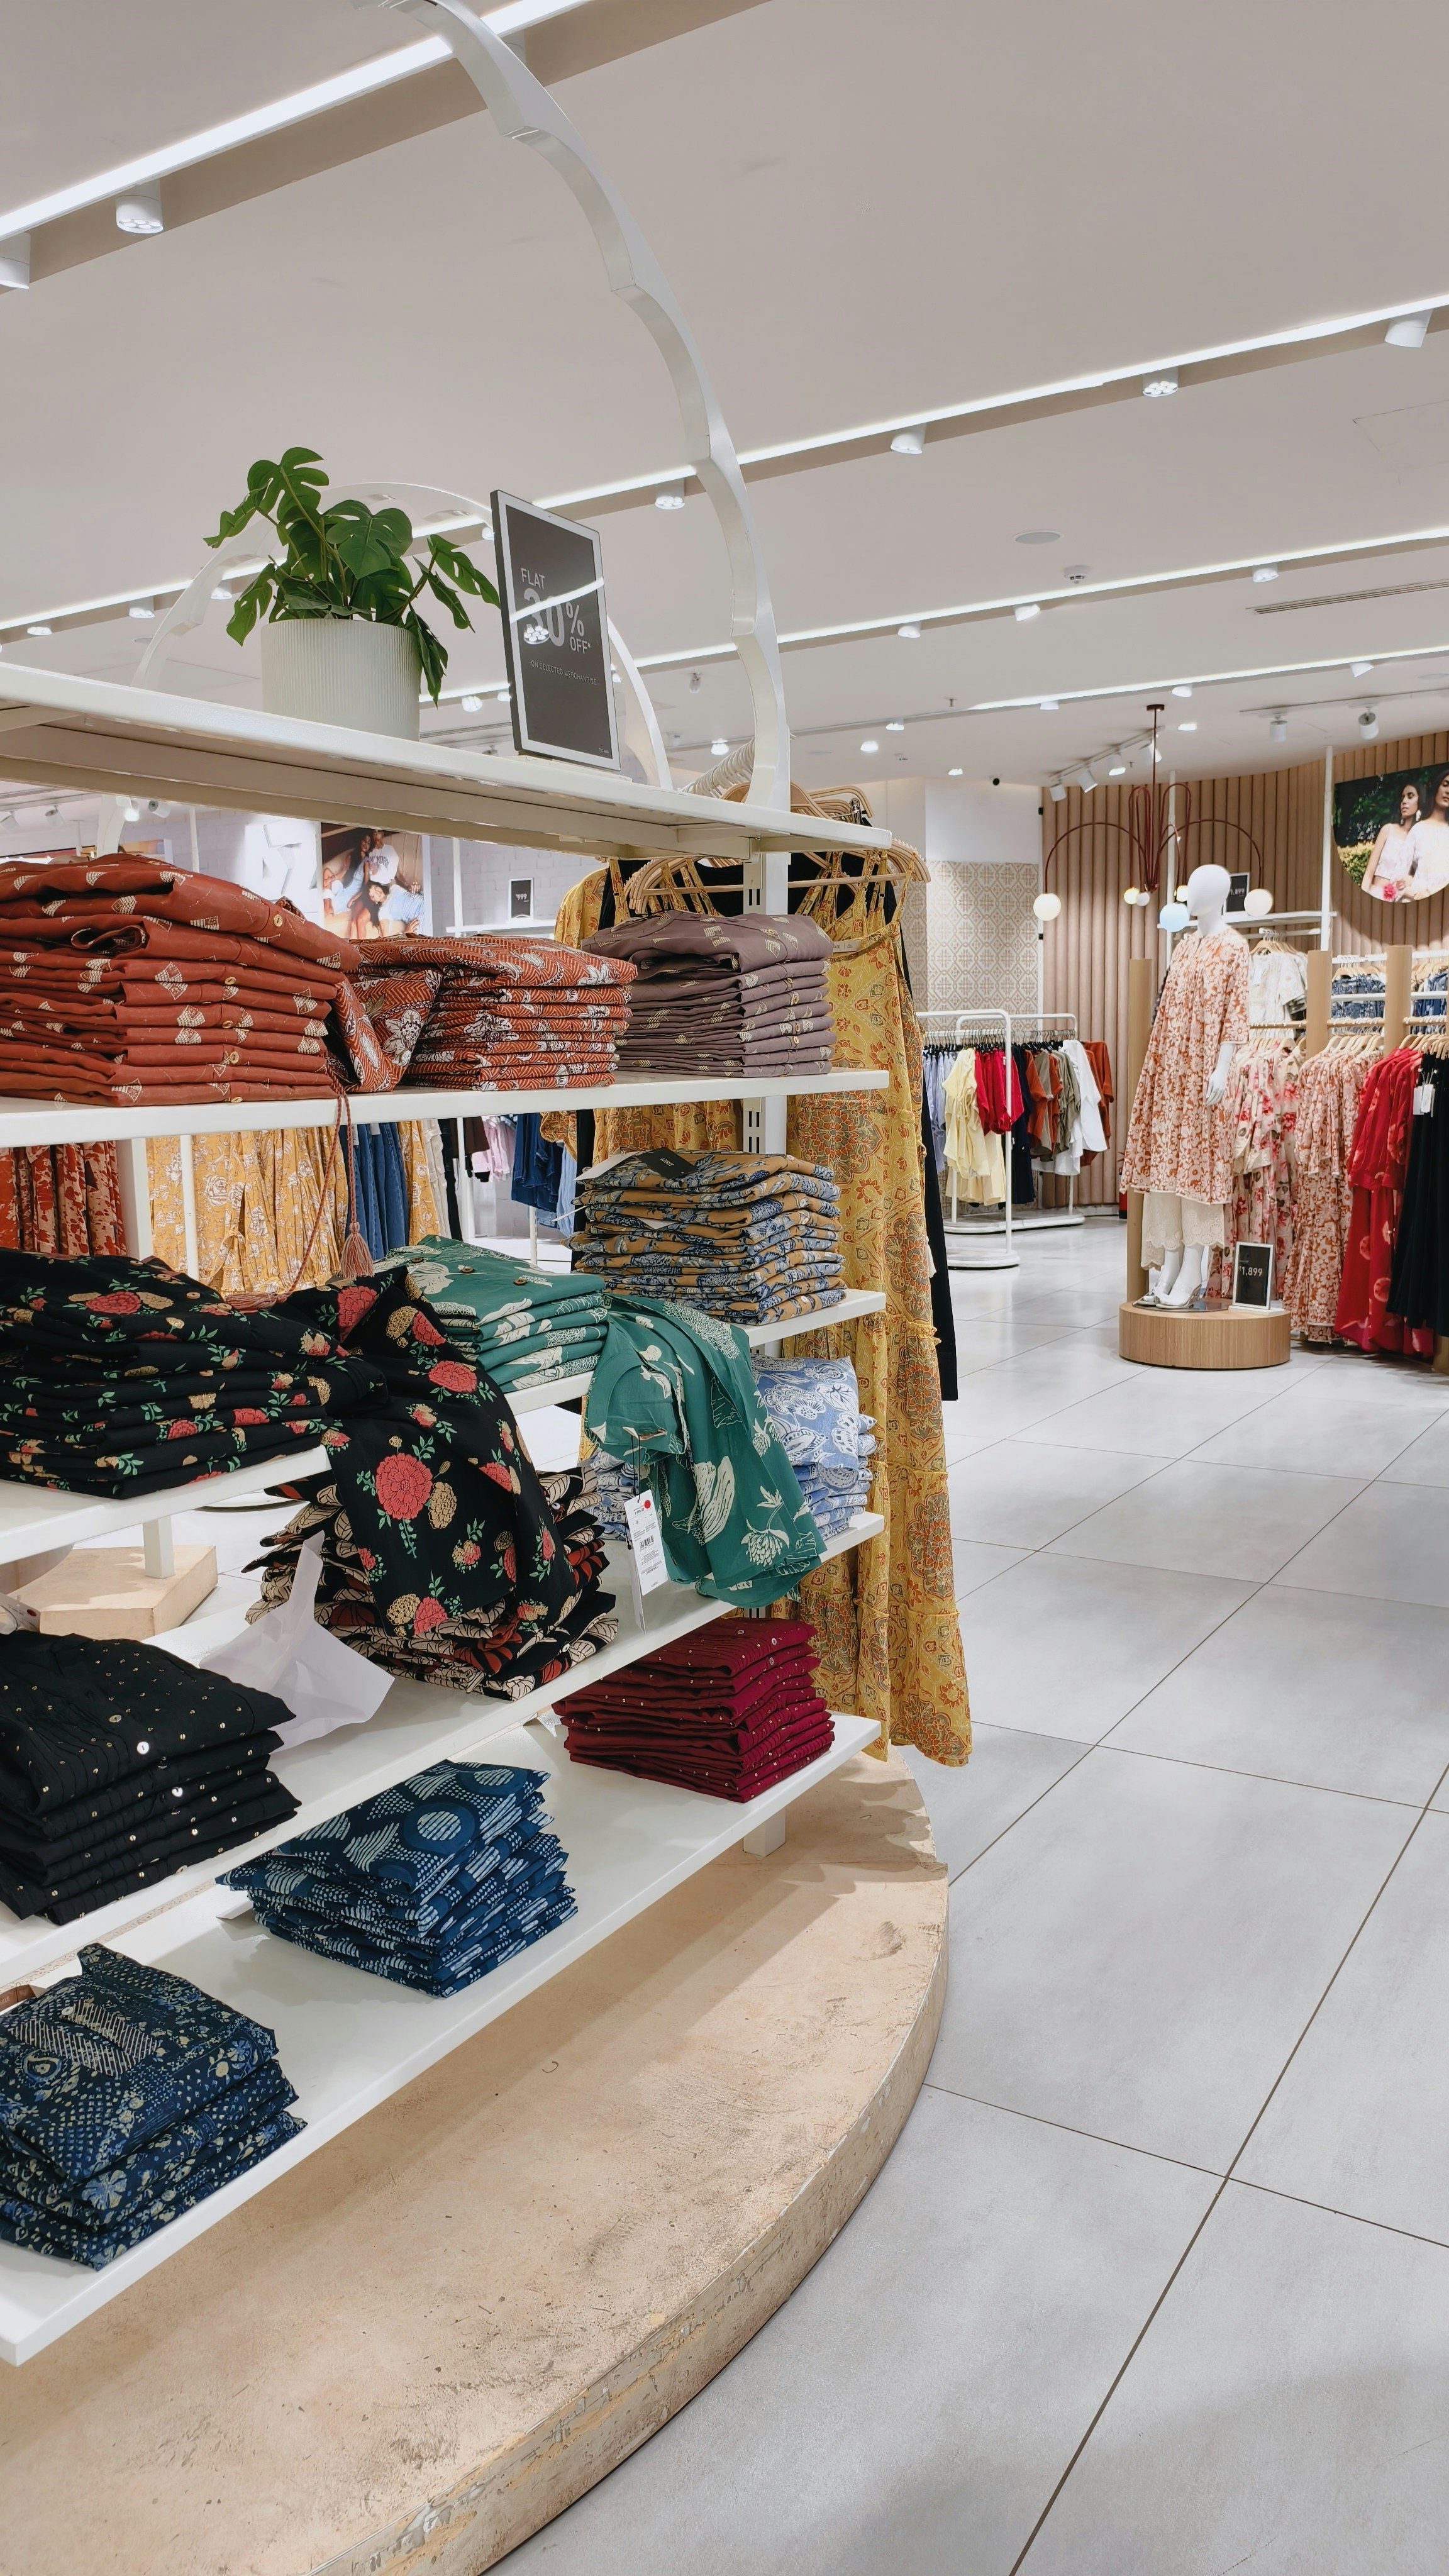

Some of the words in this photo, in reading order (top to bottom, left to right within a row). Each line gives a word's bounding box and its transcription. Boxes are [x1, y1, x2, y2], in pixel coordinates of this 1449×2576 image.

[521, 567, 545, 590] FLAT
[531, 660, 539, 669] ON
[540, 662, 563, 675] SELECTED
[564, 669, 597, 686] MERCHANDISE
